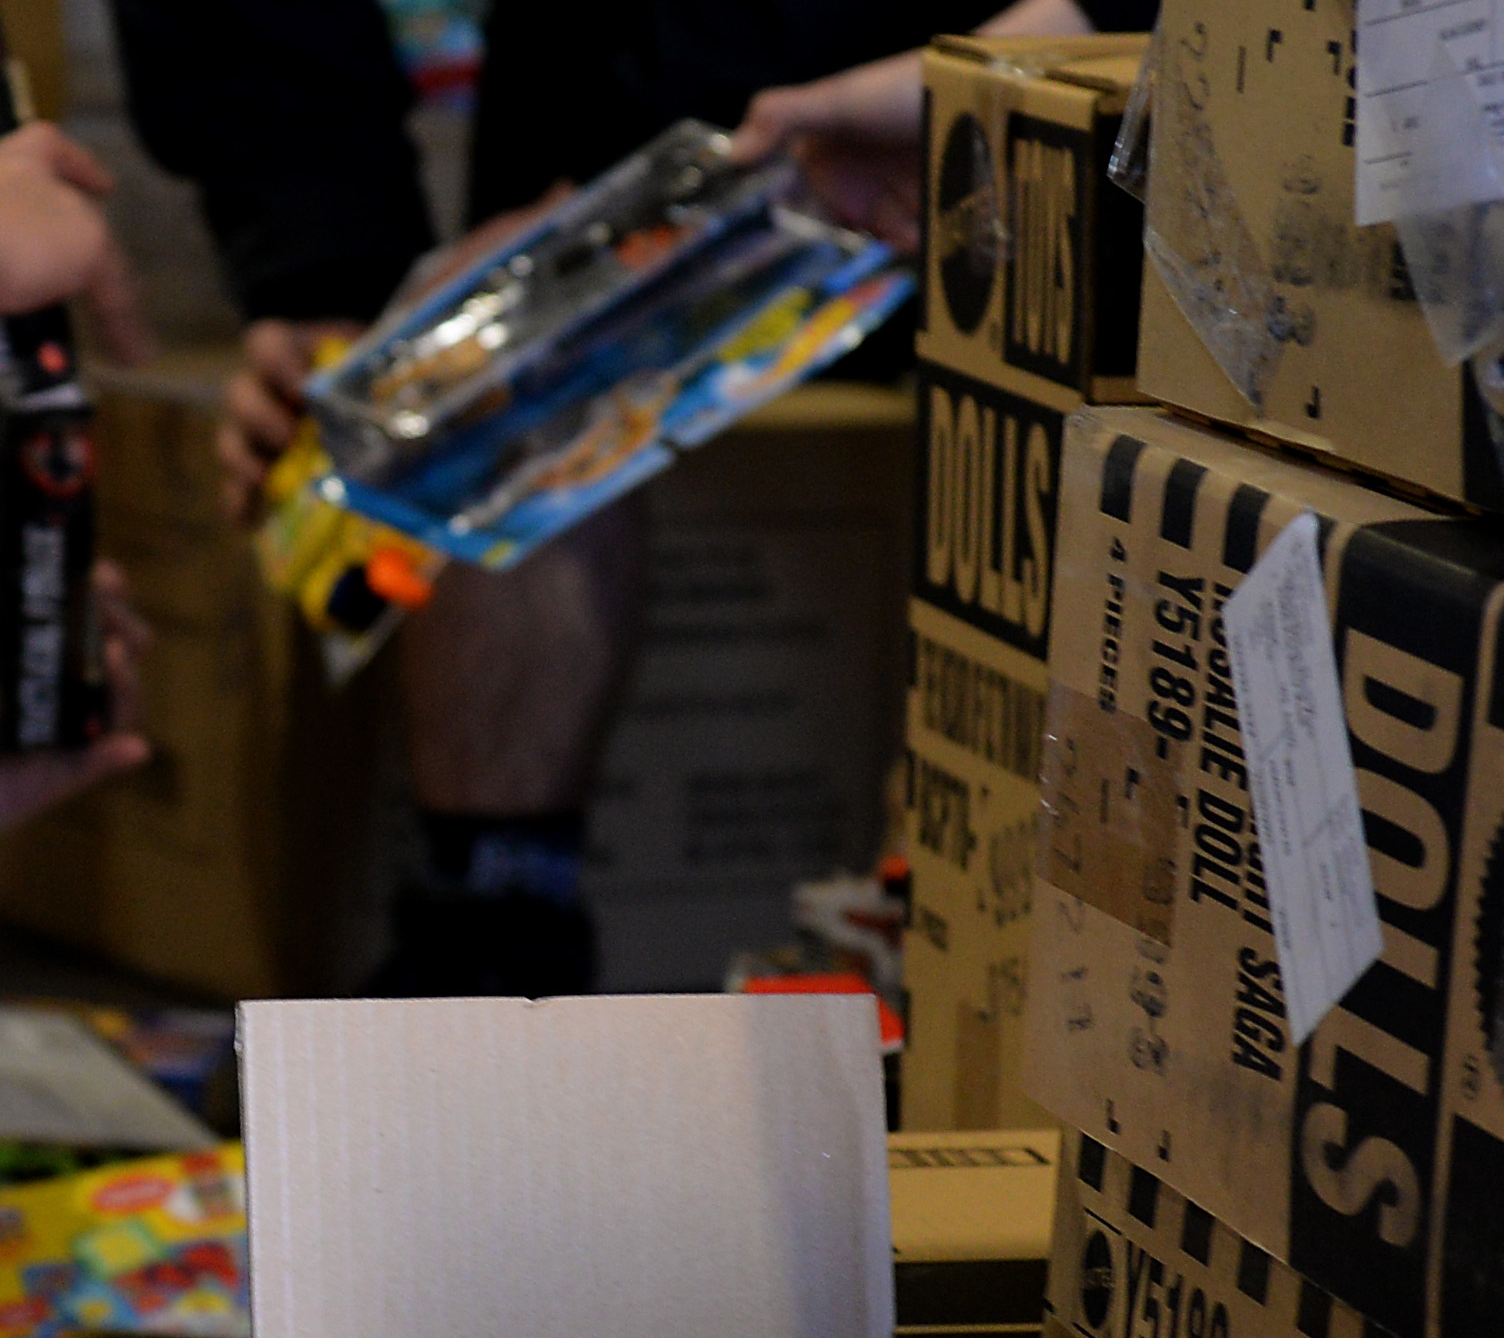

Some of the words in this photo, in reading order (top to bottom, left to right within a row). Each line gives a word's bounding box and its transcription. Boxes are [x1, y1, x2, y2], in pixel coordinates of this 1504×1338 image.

[926, 385, 1052, 641] DOLLS
[1095, 575, 1124, 713] PIECES
[1147, 571, 1204, 759] Y5189-
[1191, 789, 1244, 913] DOLL
[1232, 947, 1283, 1084] SAGA
